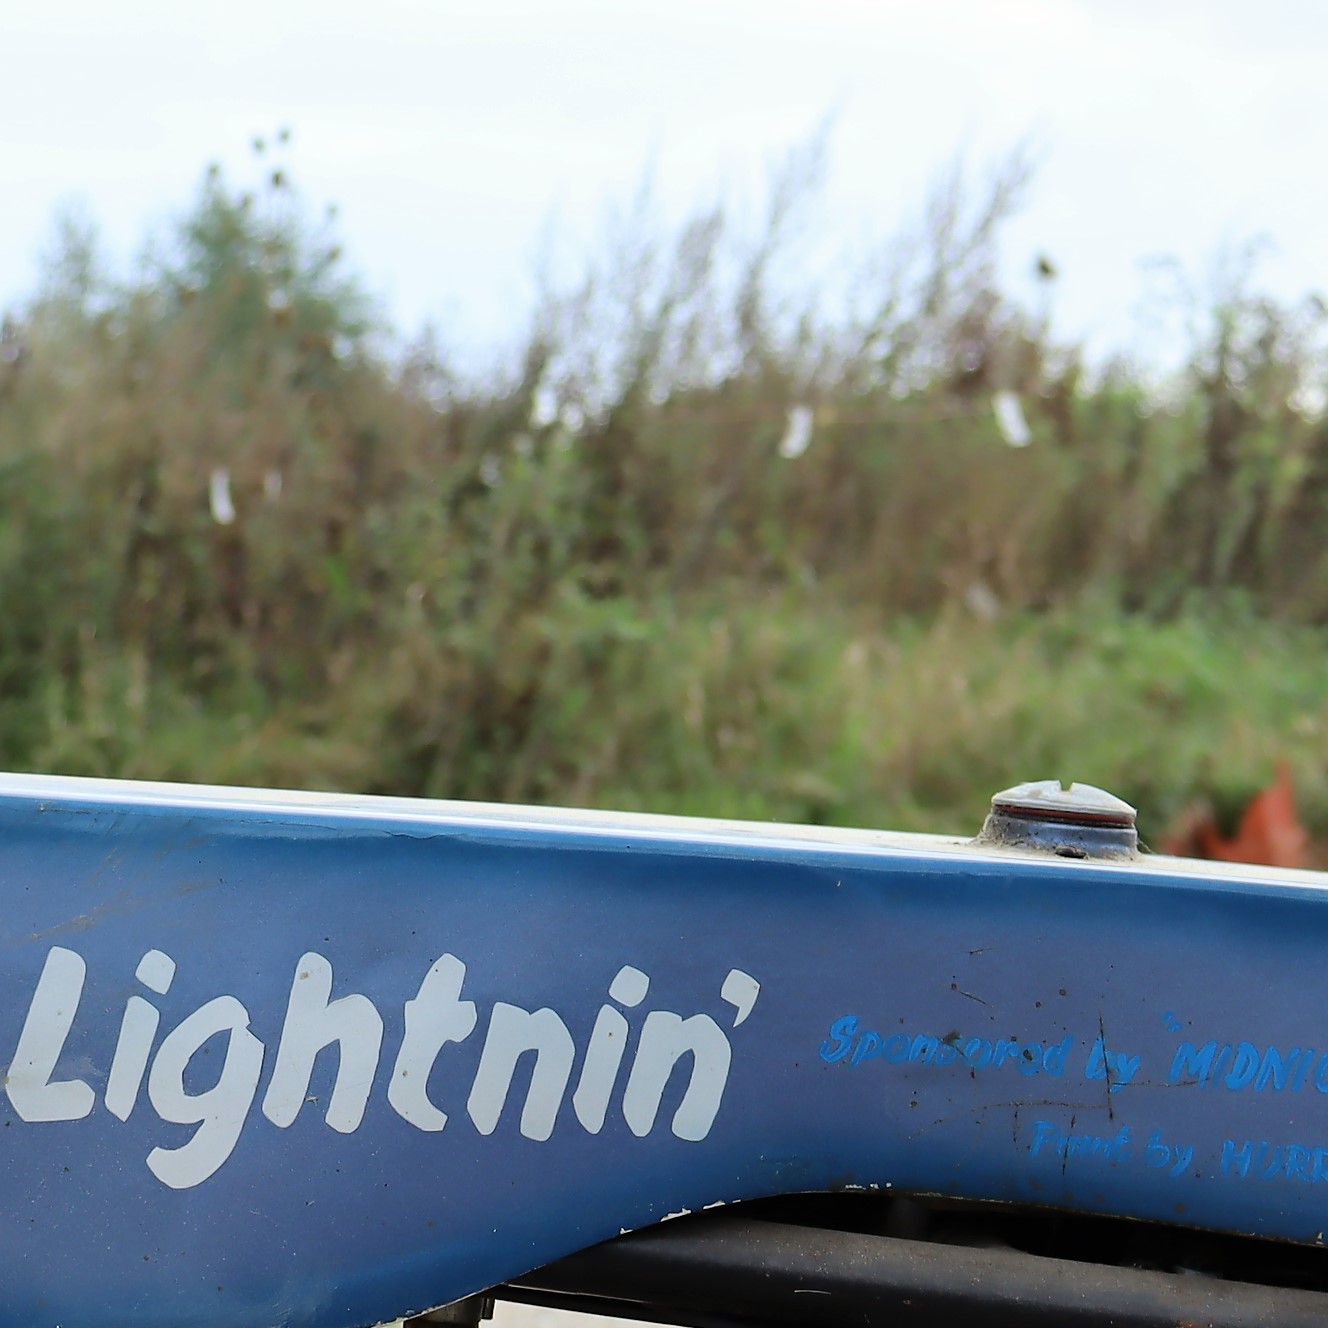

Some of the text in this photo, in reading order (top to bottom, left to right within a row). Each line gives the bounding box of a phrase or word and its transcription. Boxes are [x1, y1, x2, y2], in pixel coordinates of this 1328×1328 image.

[818, 1014, 1075, 1076] Sponsored
[1083, 1034, 1141, 1094] by
[1144, 1127, 1194, 1178] by
